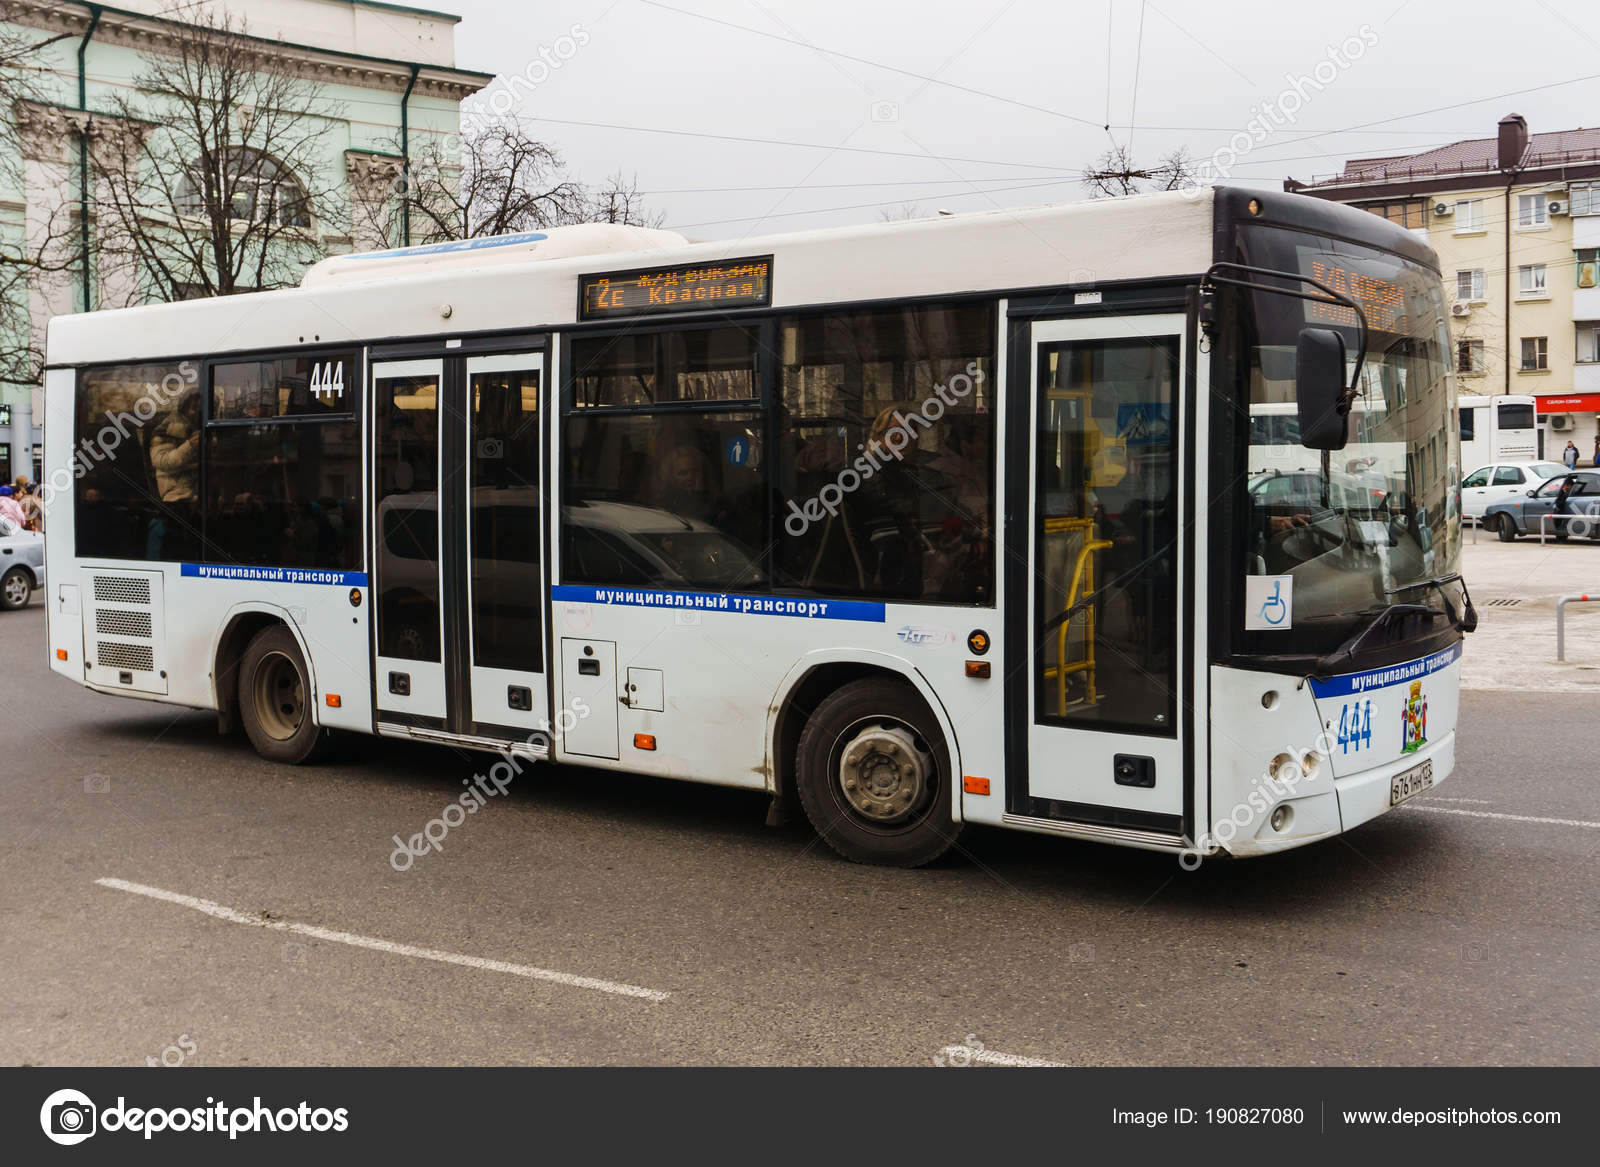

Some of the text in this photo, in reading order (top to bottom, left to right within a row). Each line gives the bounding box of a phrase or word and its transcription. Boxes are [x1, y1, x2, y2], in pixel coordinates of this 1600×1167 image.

[649, 283, 753, 304] Красная
[310, 361, 344, 399] 444
[199, 566, 345, 586] муниципальный транспорт
[595, 590, 828, 618] муниципальный транспорт
[1351, 658, 1426, 692] муниципальный
[1337, 700, 1371, 754] 444
